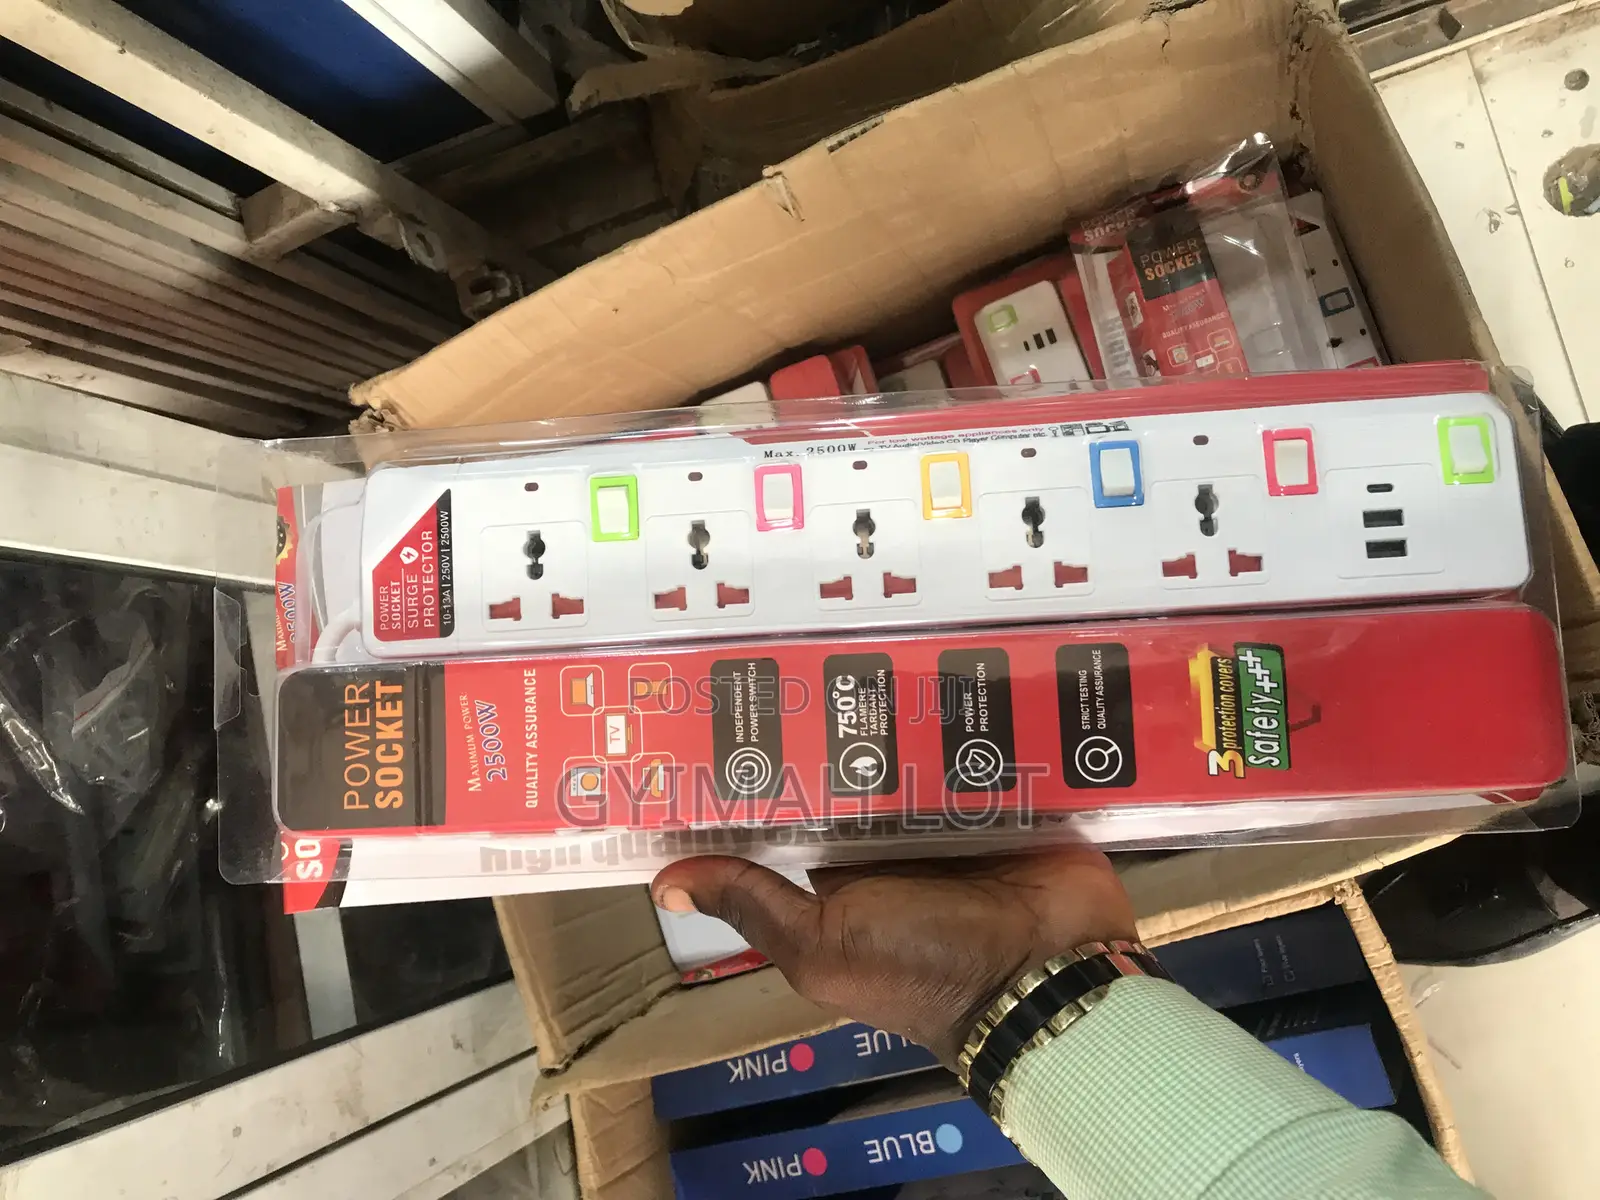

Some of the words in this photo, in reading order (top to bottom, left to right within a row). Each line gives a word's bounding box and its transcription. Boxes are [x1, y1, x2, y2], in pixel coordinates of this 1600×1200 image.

[1140, 237, 1198, 268] POWER
[1144, 252, 1202, 281] SOCKET
[958, 428, 1017, 440] appliances
[440, 510, 450, 546] 2500W
[421, 530, 435, 628] PROTECTOR
[441, 555, 451, 580] 250V
[379, 585, 390, 631] POWER
[390, 580, 401, 630] SOCKET
[406, 573, 419, 629] SURGE
[442, 589, 452, 625] 10-13A
[747, 661, 757, 703] SWITCH
[1078, 669, 1090, 704] TESTING
[1092, 649, 1104, 697] ASSURANCE
[1216, 657, 1234, 693] covers
[523, 668, 538, 749] ASSURANCE
[732, 670, 744, 743] INDEPENDENT
[857, 686, 869, 737] FLAMERE
[868, 687, 879, 737] TARDANT
[876, 669, 889, 736] PROTECTION
[963, 691, 975, 733] POWER
[975, 662, 989, 732] PROTECTION
[1081, 703, 1091, 730] STRICT
[1096, 696, 1107, 730] QUALITY
[374, 680, 404, 809] SOCKET
[474, 699, 508, 783] 2500W
[609, 725, 621, 744] TV
[749, 710, 760, 743] POWER
[1217, 693, 1242, 750] protection
[343, 682, 371, 810] POWER
[1207, 748, 1246, 779] 3
[524, 752, 538, 809] QUALITY
[727, 1049, 788, 1084] PINK
[742, 1153, 803, 1185] PINK
[863, 1129, 936, 1164] BLUE
